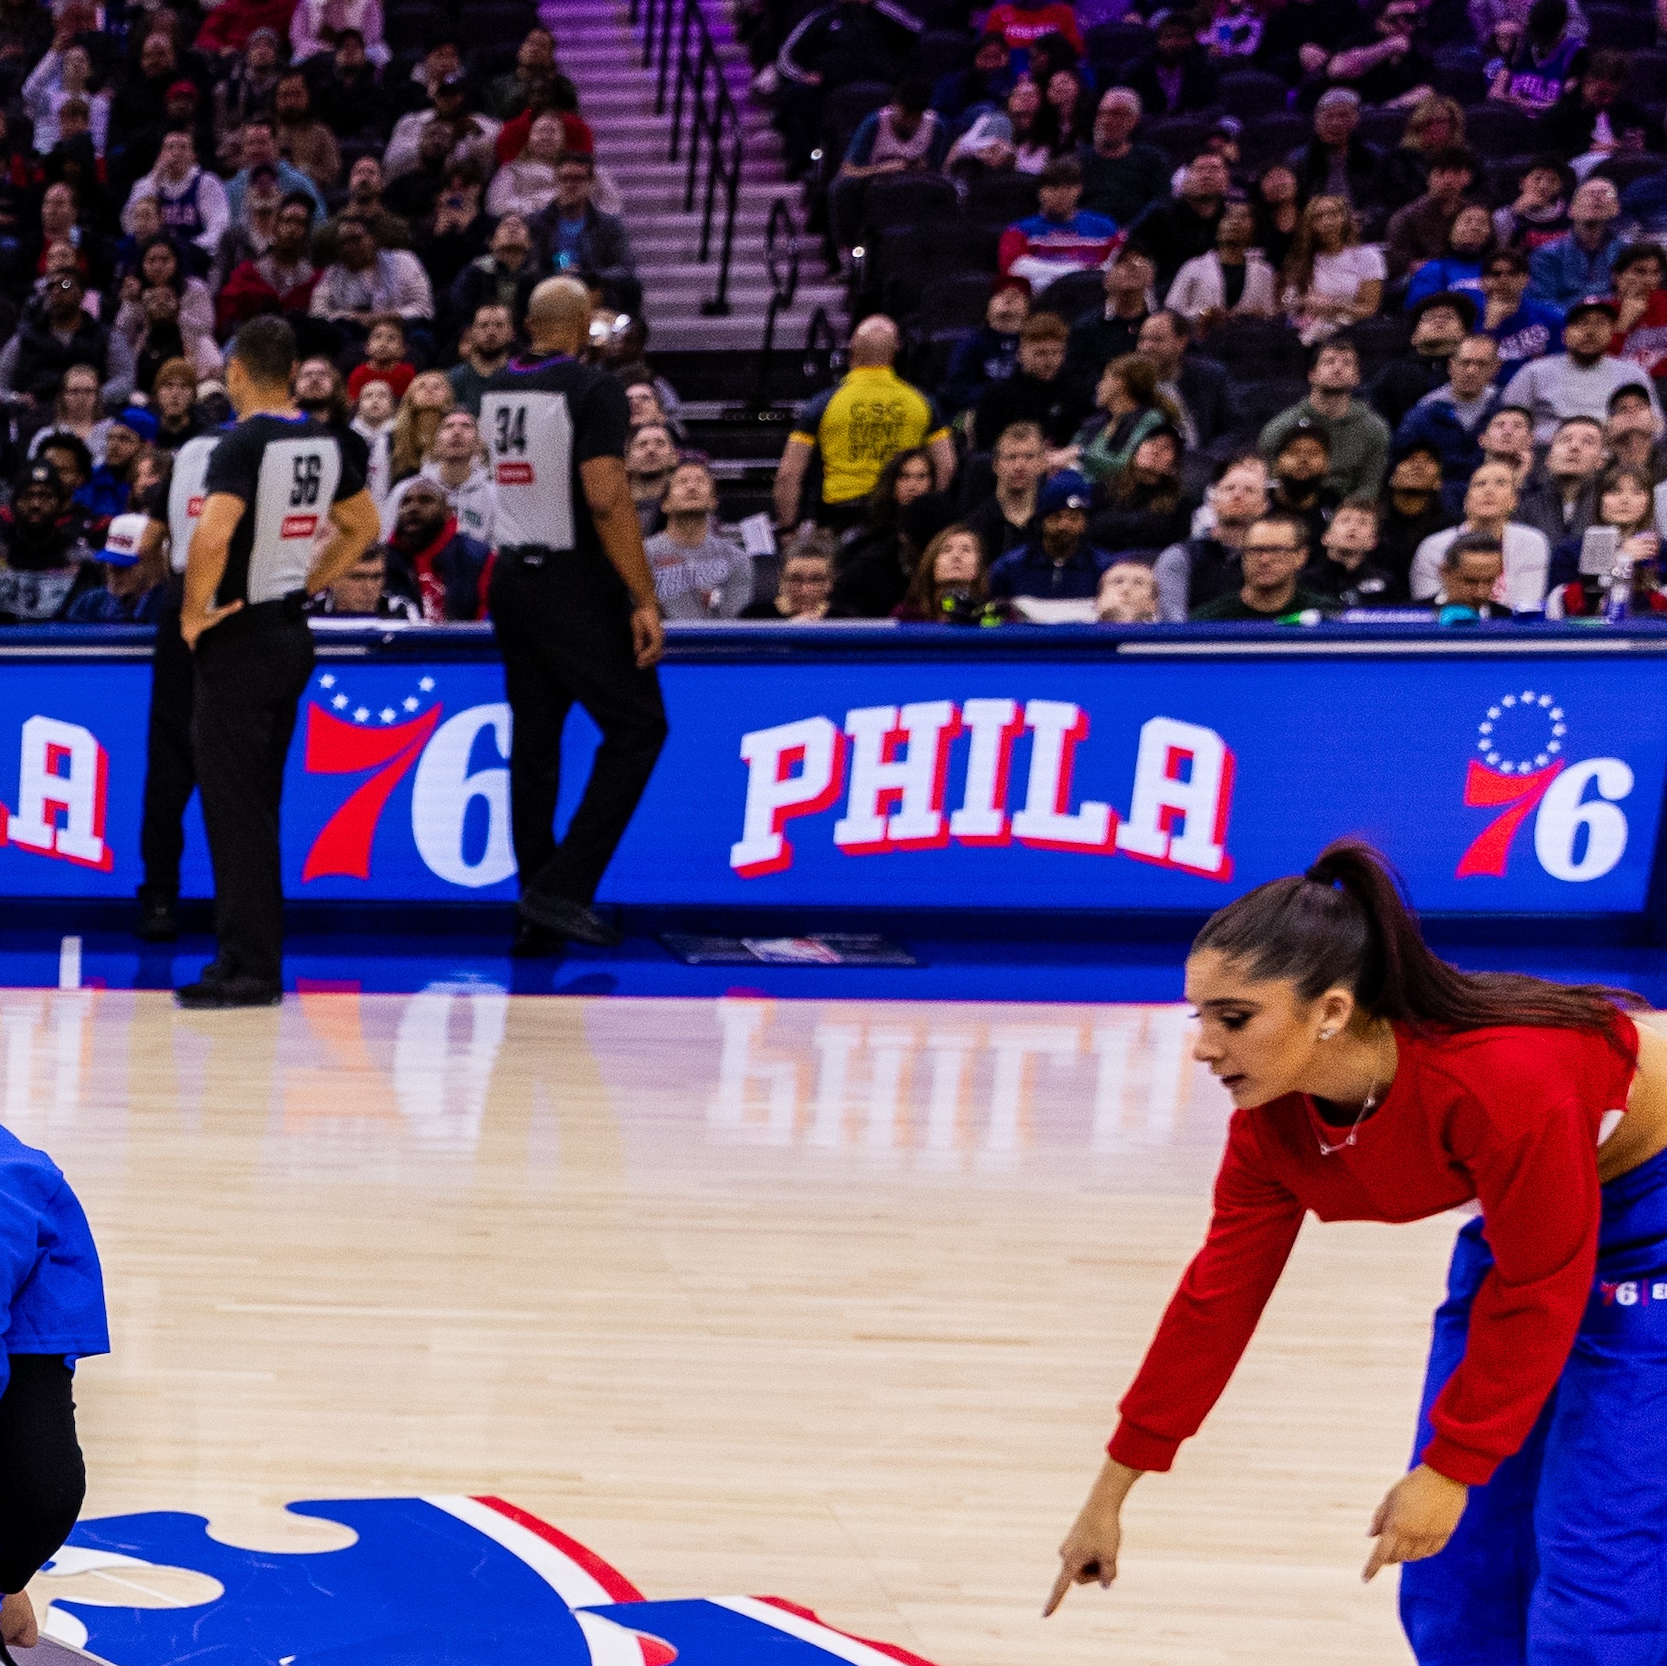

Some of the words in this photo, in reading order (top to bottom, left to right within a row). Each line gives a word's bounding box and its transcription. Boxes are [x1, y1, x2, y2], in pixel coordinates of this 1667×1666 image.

[290, 454, 321, 506] 56
[495, 405, 527, 455] 34
[302, 701, 518, 888] 76
[729, 697, 1233, 882] PHILA
[1456, 757, 1635, 882] 76
